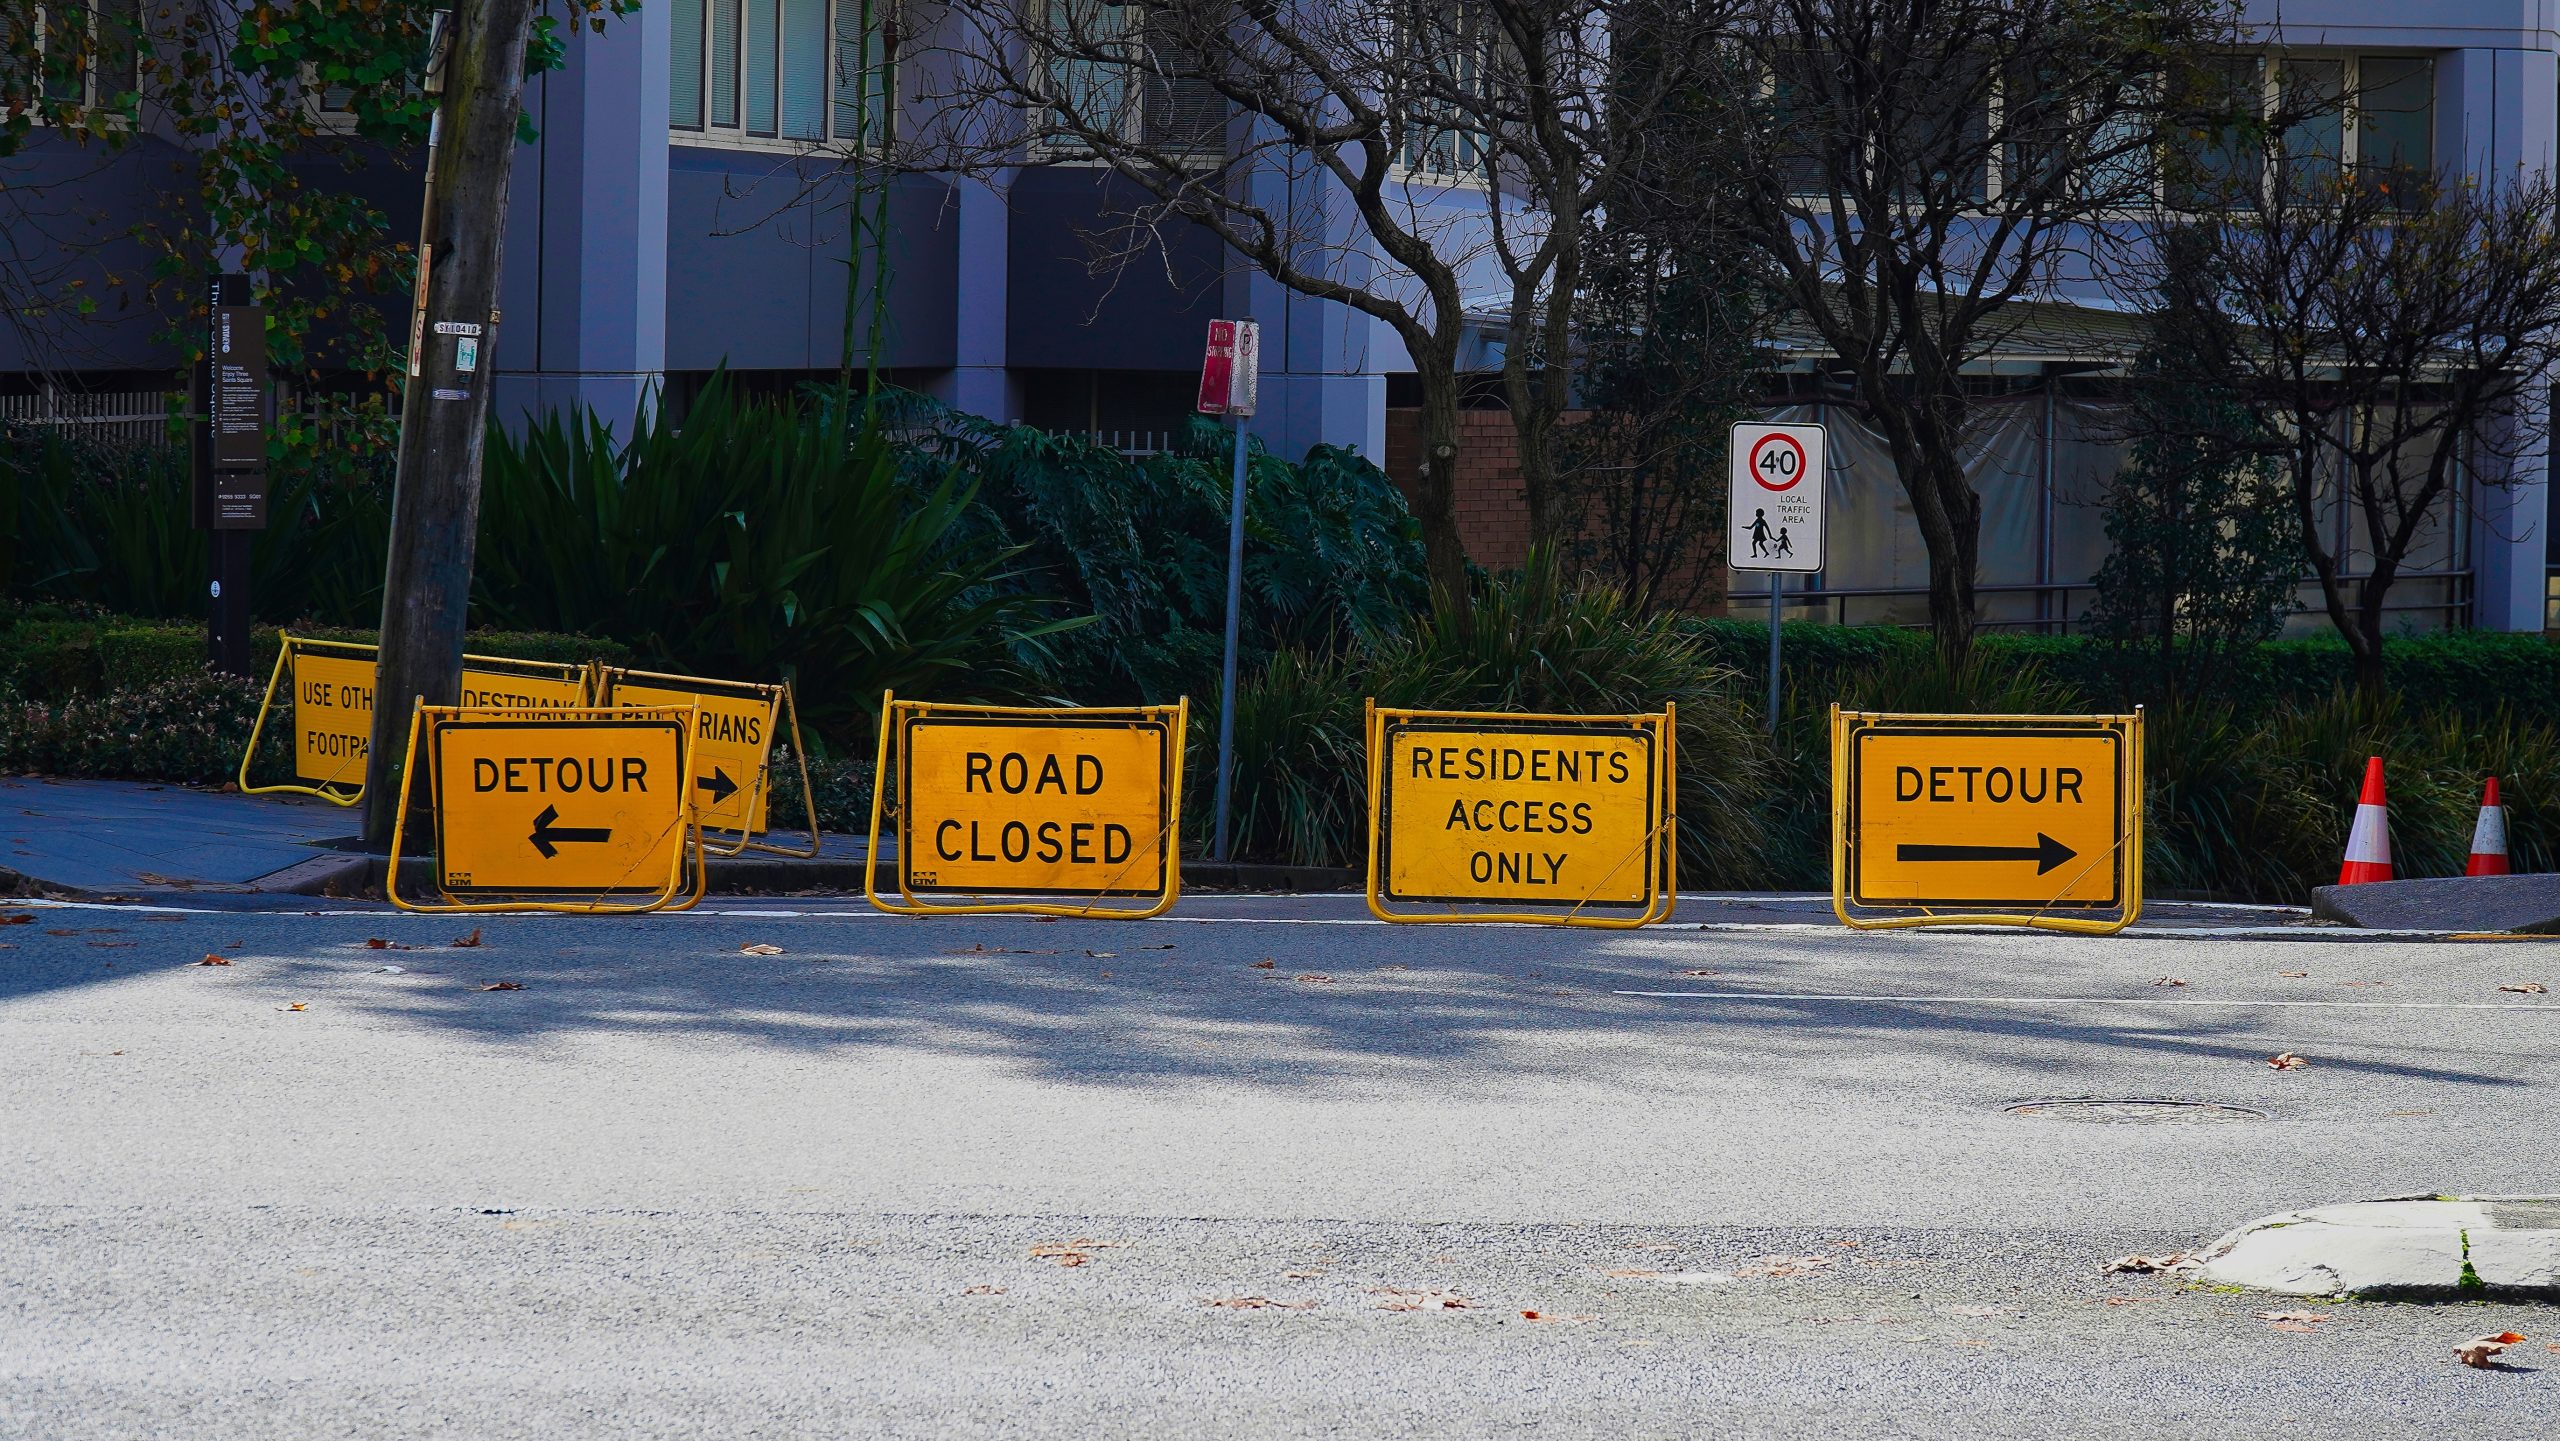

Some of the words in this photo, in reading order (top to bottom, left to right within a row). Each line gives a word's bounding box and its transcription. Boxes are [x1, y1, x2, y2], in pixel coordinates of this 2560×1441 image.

[1215, 328, 1227, 341] NO
[1759, 450, 1796, 475] 40
[1777, 506, 1811, 514] TRAFFIC
[1782, 516, 1805, 524] AREA
[304, 681, 333, 707] USE
[341, 686, 373, 711] OTH
[463, 689, 580, 720] DESTRIAN
[621, 702, 761, 745] PSRIANS
[308, 730, 369, 759] FOOTPA
[474, 757, 648, 793] DETOUR
[966, 752, 1104, 795] ROAD
[1412, 747, 1629, 783] RESIDENTS
[1896, 766, 2083, 804] DETOUR
[1445, 799, 1593, 834] ACCESS
[935, 819, 1132, 864] CLOSED
[1470, 852, 1568, 884] ONLY
